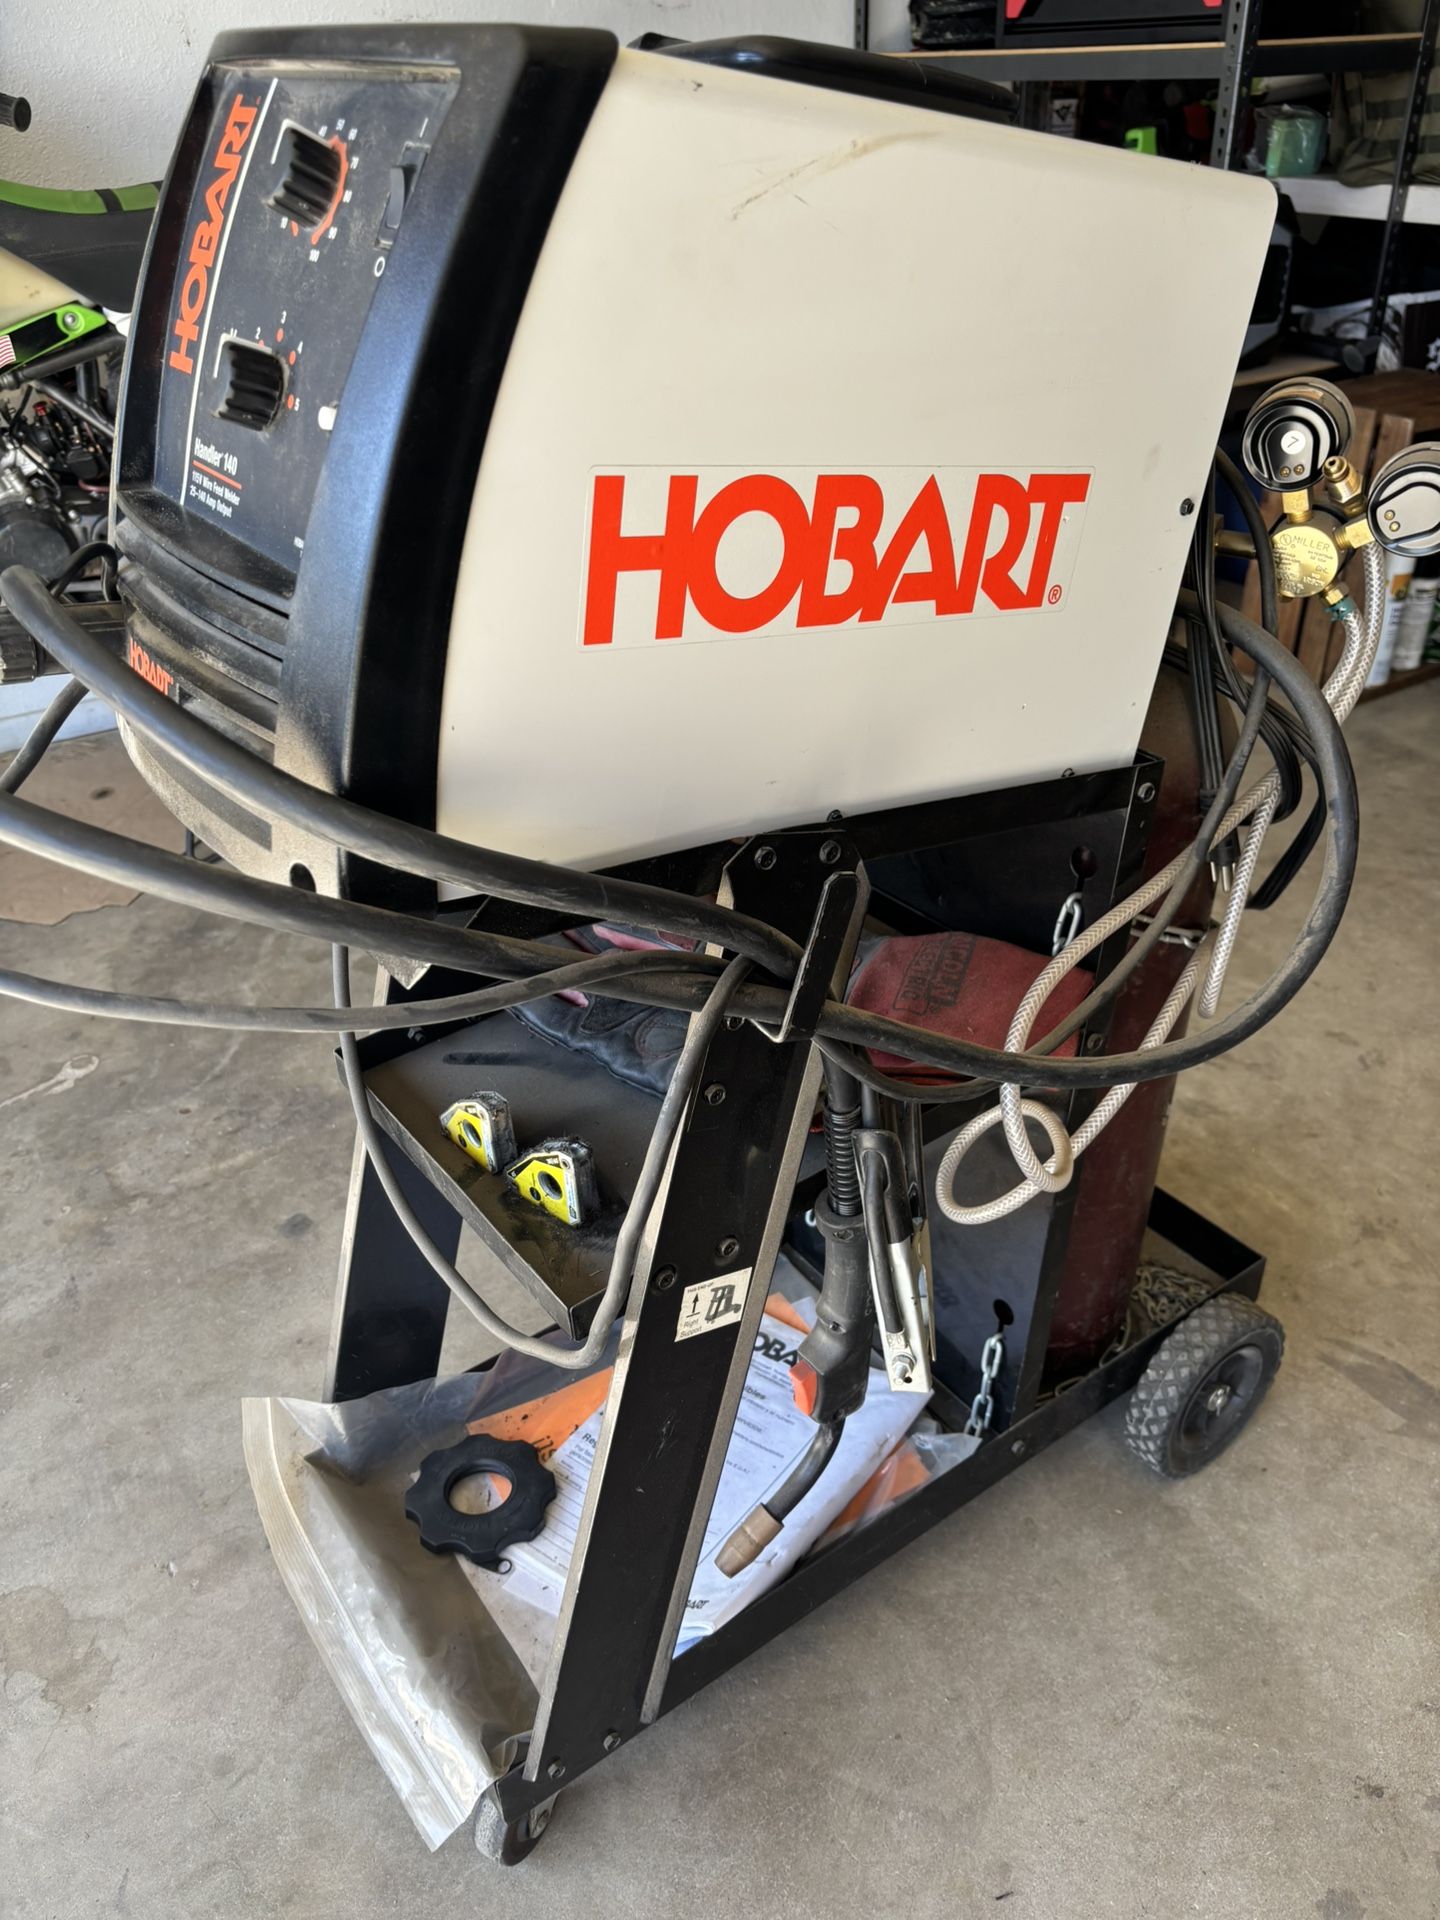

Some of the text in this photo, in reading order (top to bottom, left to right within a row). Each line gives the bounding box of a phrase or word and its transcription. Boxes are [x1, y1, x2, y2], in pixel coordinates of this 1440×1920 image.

[169, 94, 258, 375] HOBART
[281, 310, 287, 324] 3
[255, 326, 261, 340] 2
[297, 341, 303, 354] 4
[294, 397, 300, 411] 5
[224, 452, 238, 476] 140
[1292, 535, 1330, 552] MILLER
[583, 473, 1091, 646] HOBART
[683, 1319, 699, 1328] Right
[680, 1327, 702, 1338] Support
[753, 1332, 798, 1366] OBA
